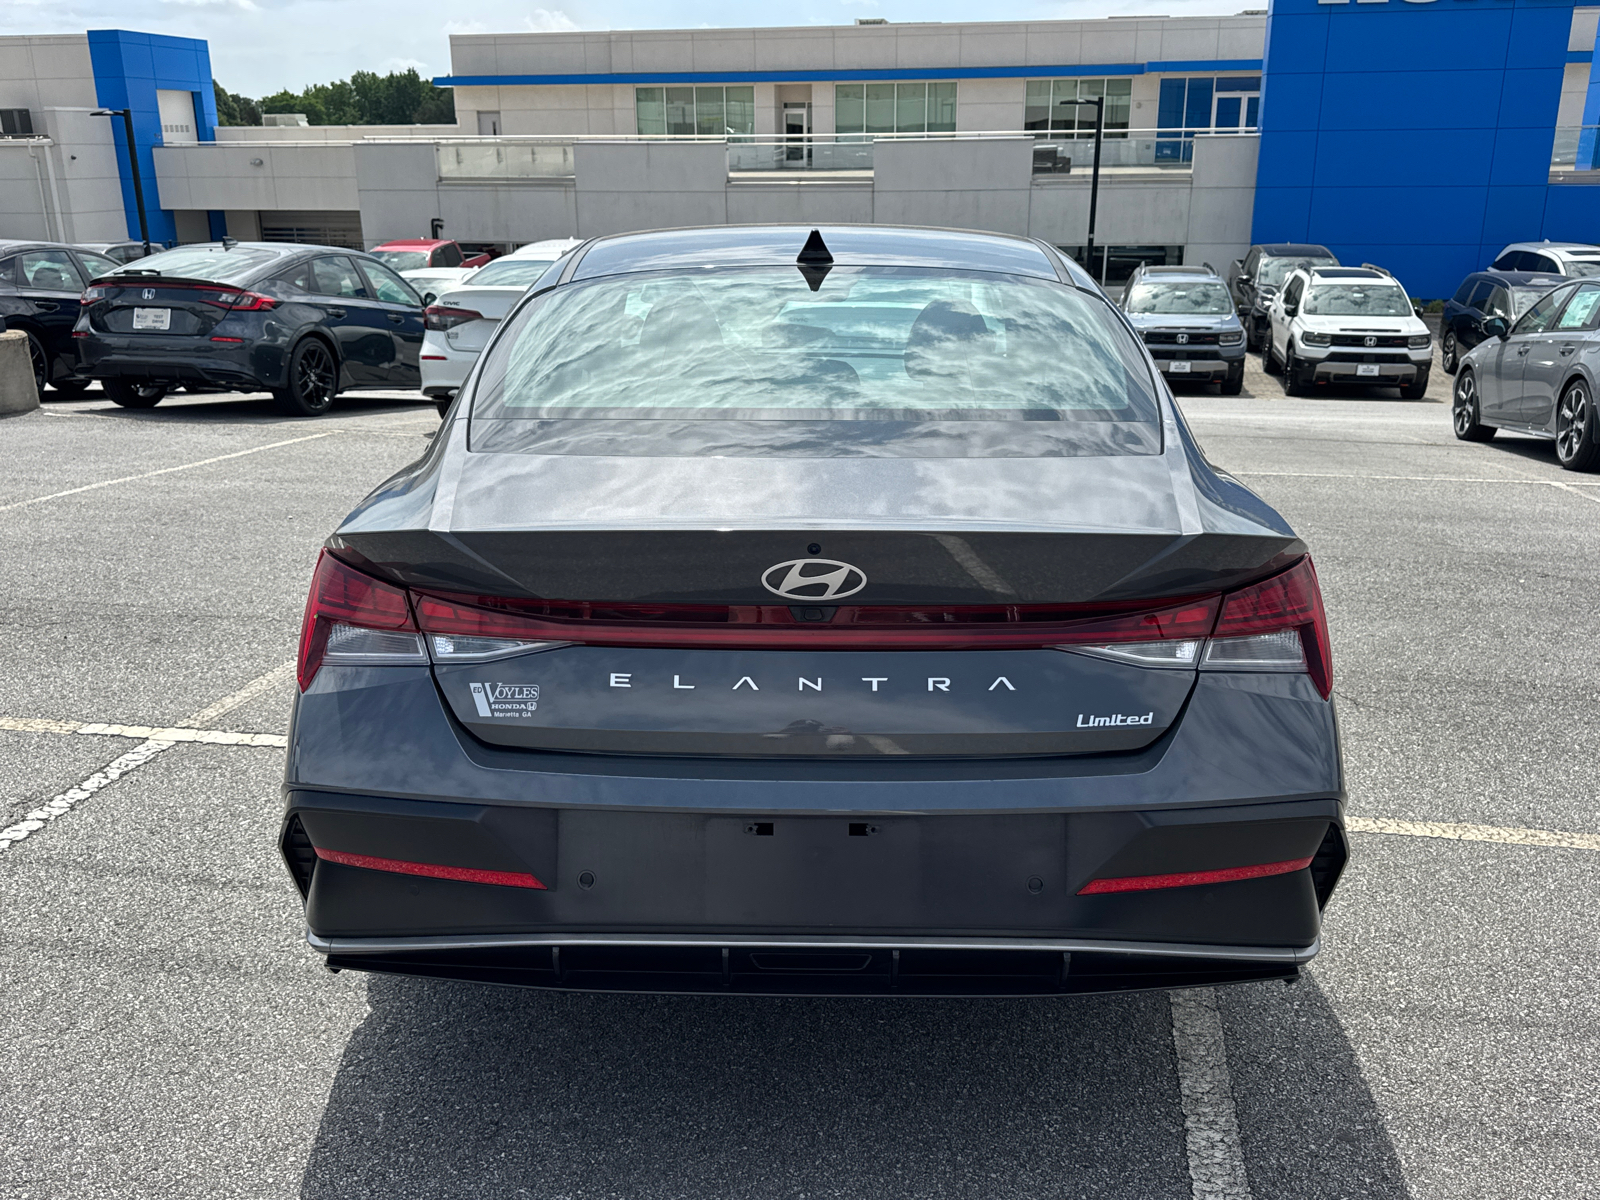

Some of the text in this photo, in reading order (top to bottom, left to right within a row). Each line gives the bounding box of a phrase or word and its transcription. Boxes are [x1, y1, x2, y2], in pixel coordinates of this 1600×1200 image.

[609, 672, 1017, 692] ELANTRA
[472, 682, 539, 703] ED VOYLES
[1076, 711, 1154, 728] Limited
